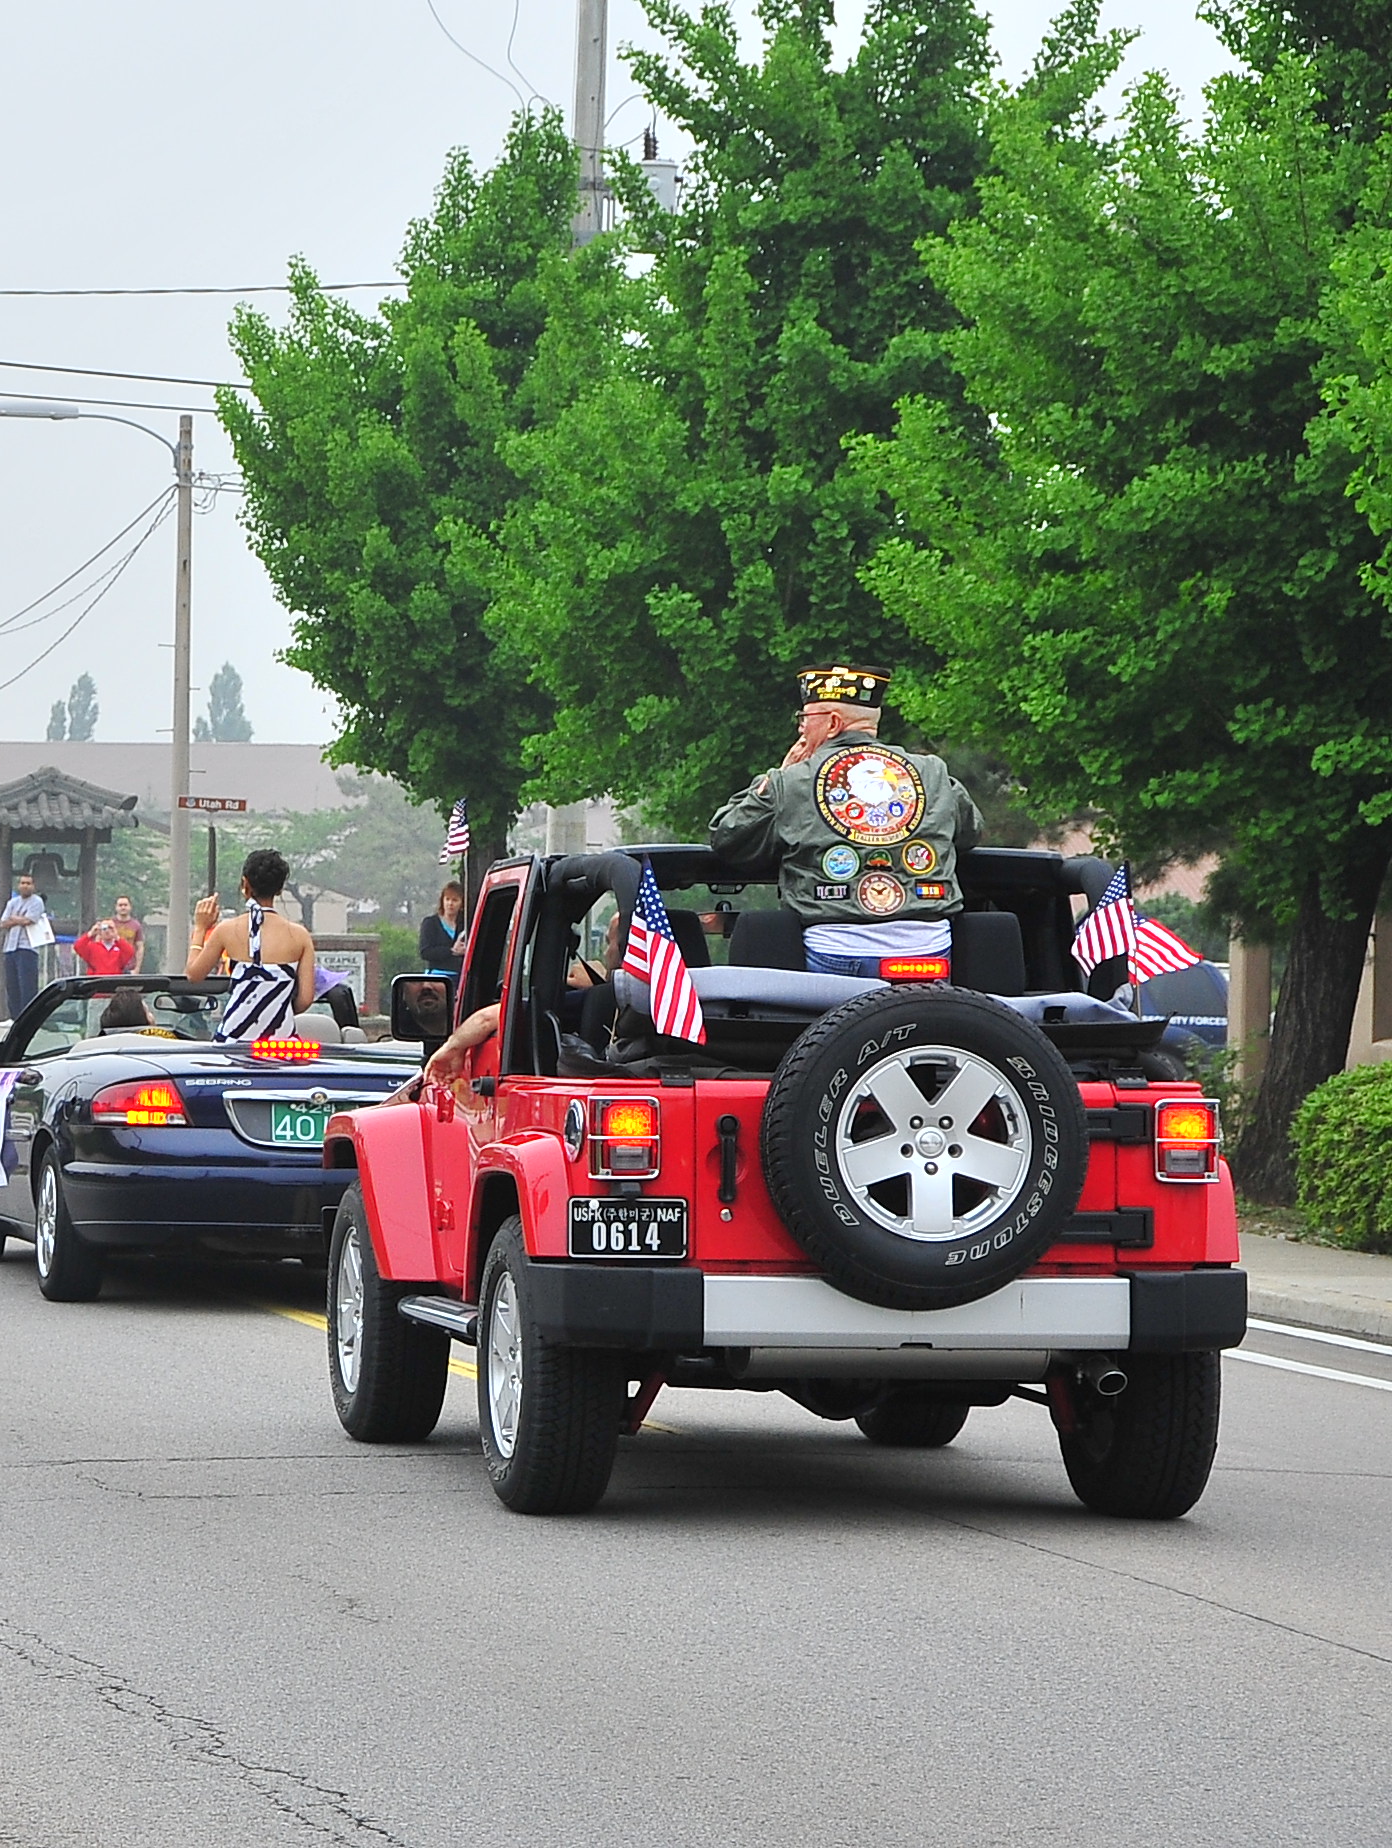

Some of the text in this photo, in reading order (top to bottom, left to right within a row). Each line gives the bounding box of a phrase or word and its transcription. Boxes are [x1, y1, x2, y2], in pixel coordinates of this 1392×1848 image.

[198, 799, 240, 810] Utah Rd
[1189, 1016, 1228, 1026] FORCES
[185, 1078, 253, 1086] SEBRING
[814, 1023, 917, 1227] DUELER A/T
[945, 1056, 1059, 1266] BRIDGESTONE
[656, 1207, 682, 1222] NAF
[592, 1222, 661, 1251] 0614
